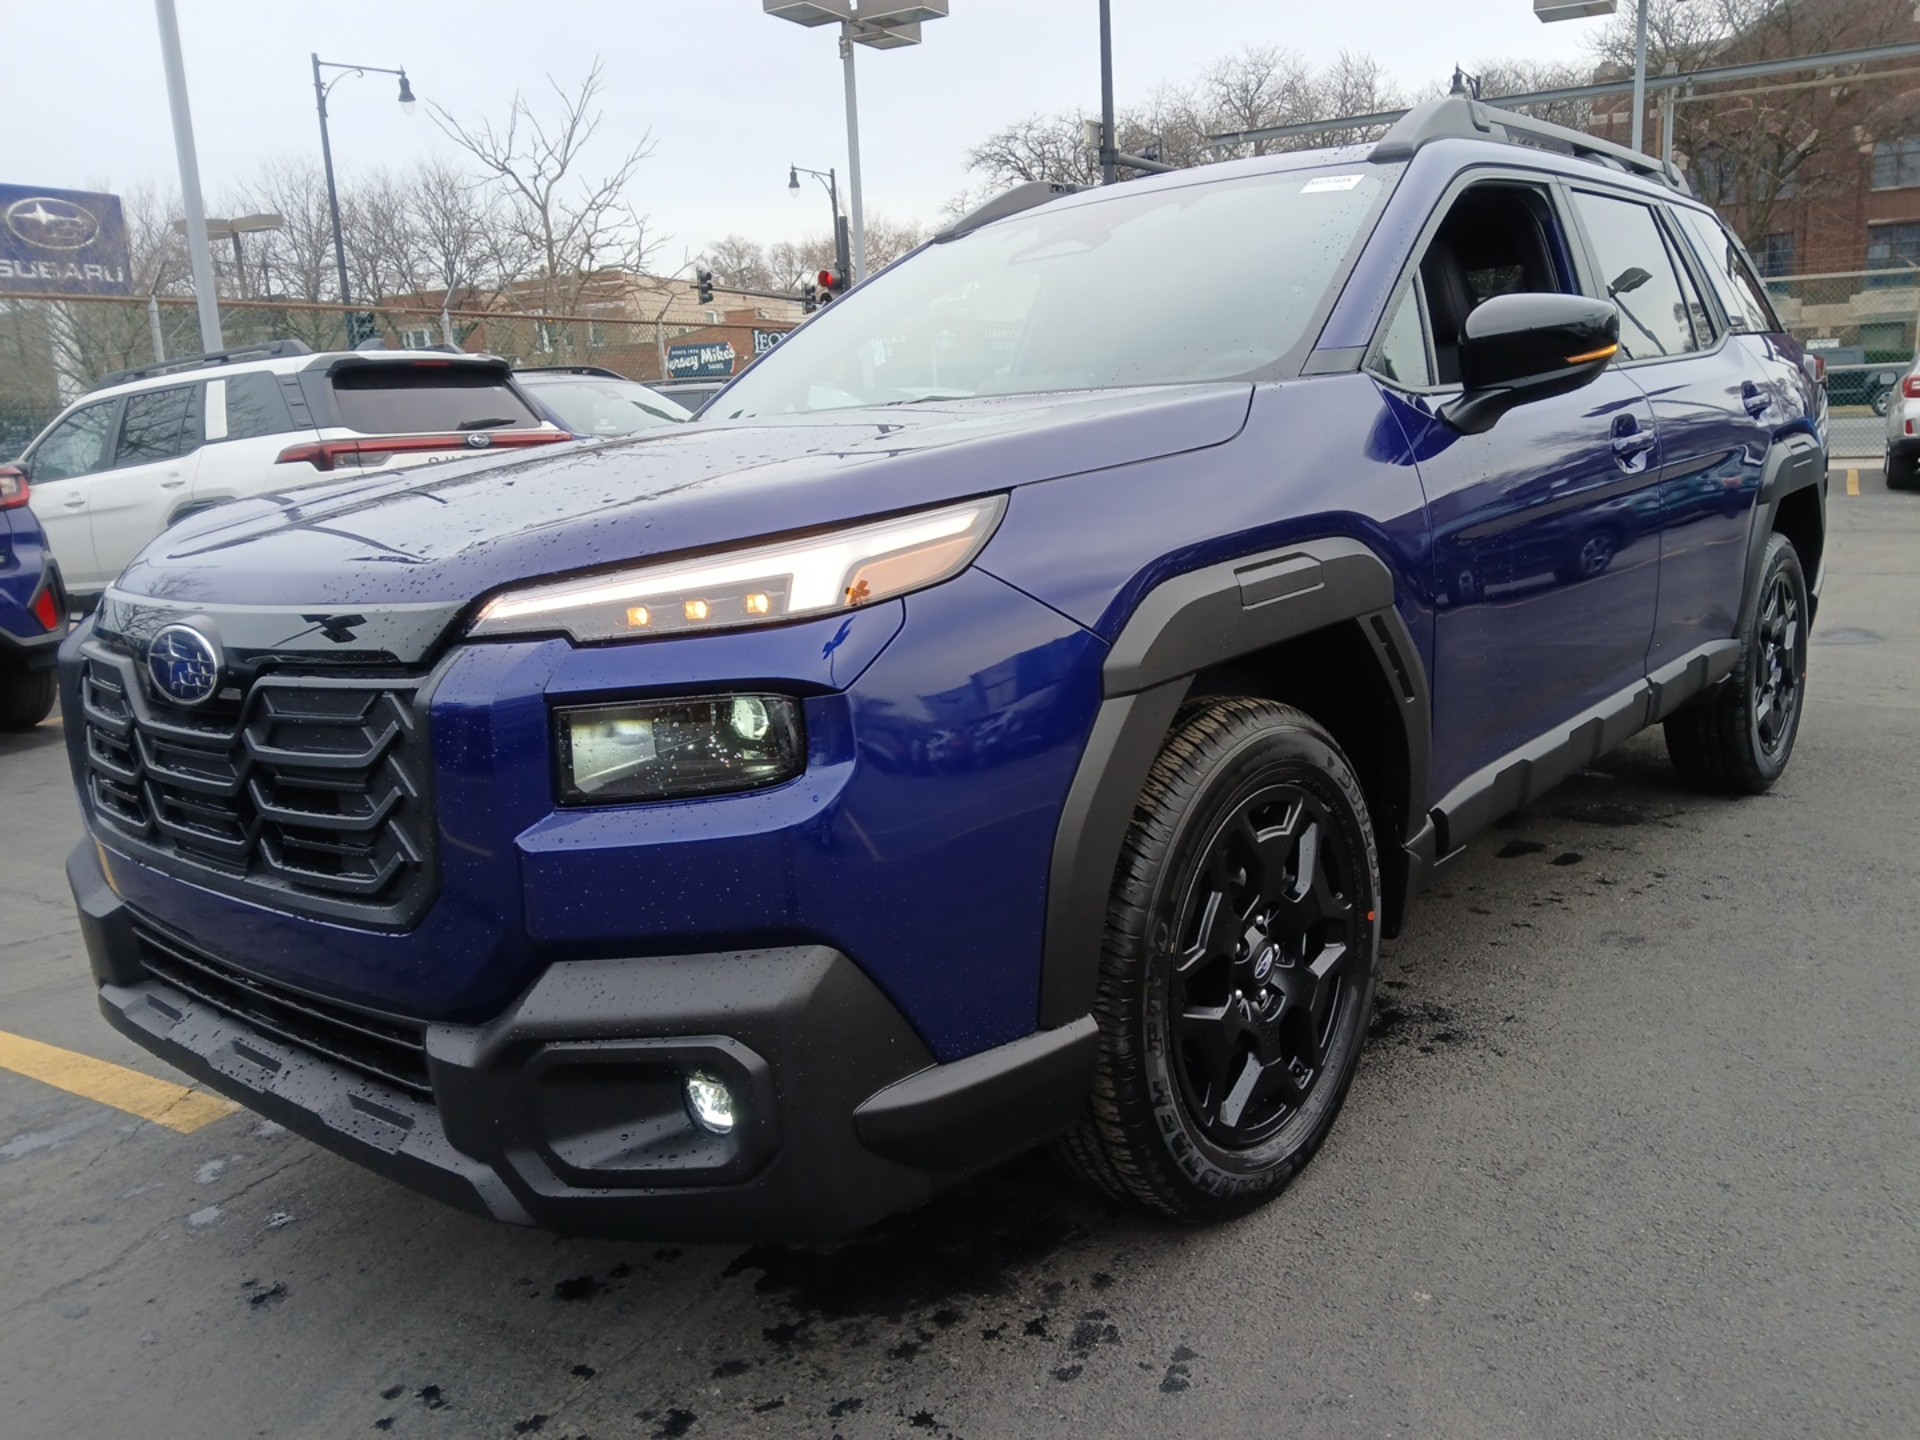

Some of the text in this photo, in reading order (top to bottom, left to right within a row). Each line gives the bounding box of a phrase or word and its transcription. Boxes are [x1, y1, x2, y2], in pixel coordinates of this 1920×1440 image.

[0, 259, 124, 282] SUBARU
[753, 330, 788, 353] LEO
[668, 355, 698, 370] ersey
[1337, 768, 1381, 897] DUNLOP
